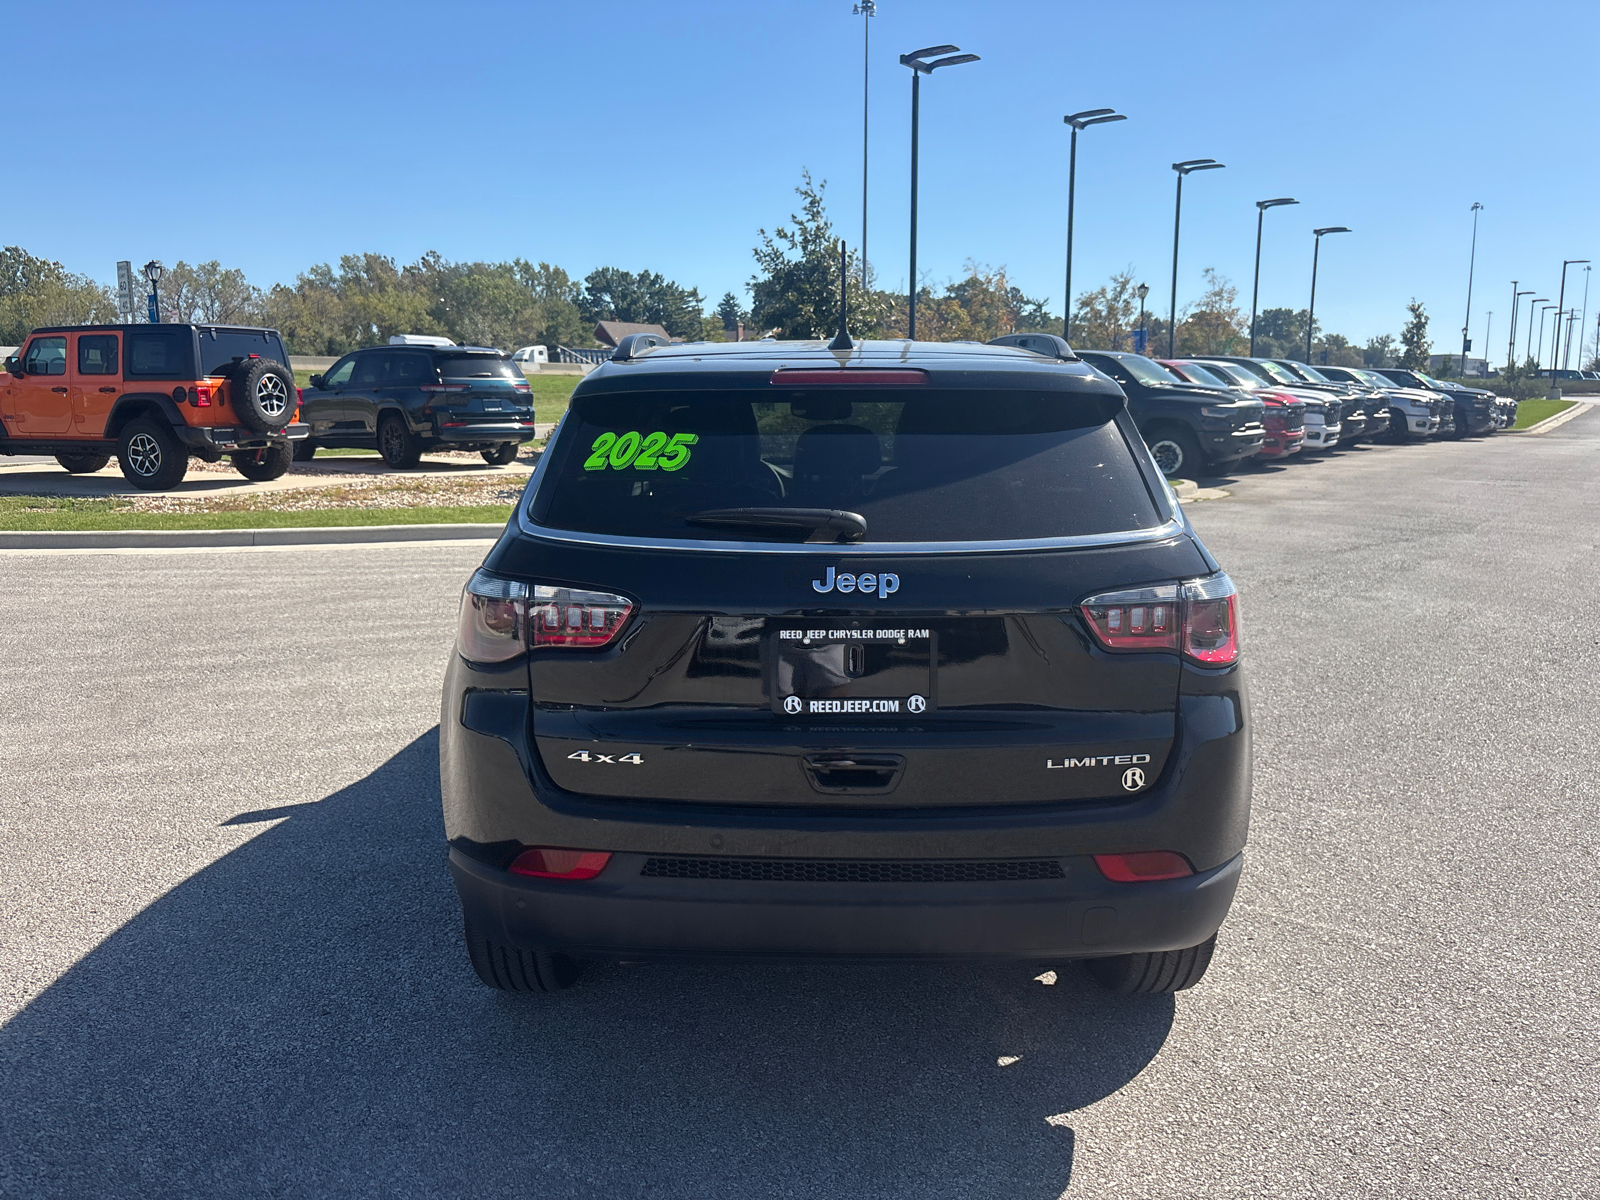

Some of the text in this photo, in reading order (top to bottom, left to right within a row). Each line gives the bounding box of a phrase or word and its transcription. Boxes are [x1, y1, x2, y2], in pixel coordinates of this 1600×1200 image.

[584, 431, 699, 471] 2025
[812, 566, 900, 598] Jeep
[780, 629, 930, 639] REED JEEP CHRYSLER DODGE RAM
[809, 700, 900, 713] REEDJEEP.COM
[567, 750, 645, 765] 4x4
[1046, 753, 1151, 769] LIMITED
